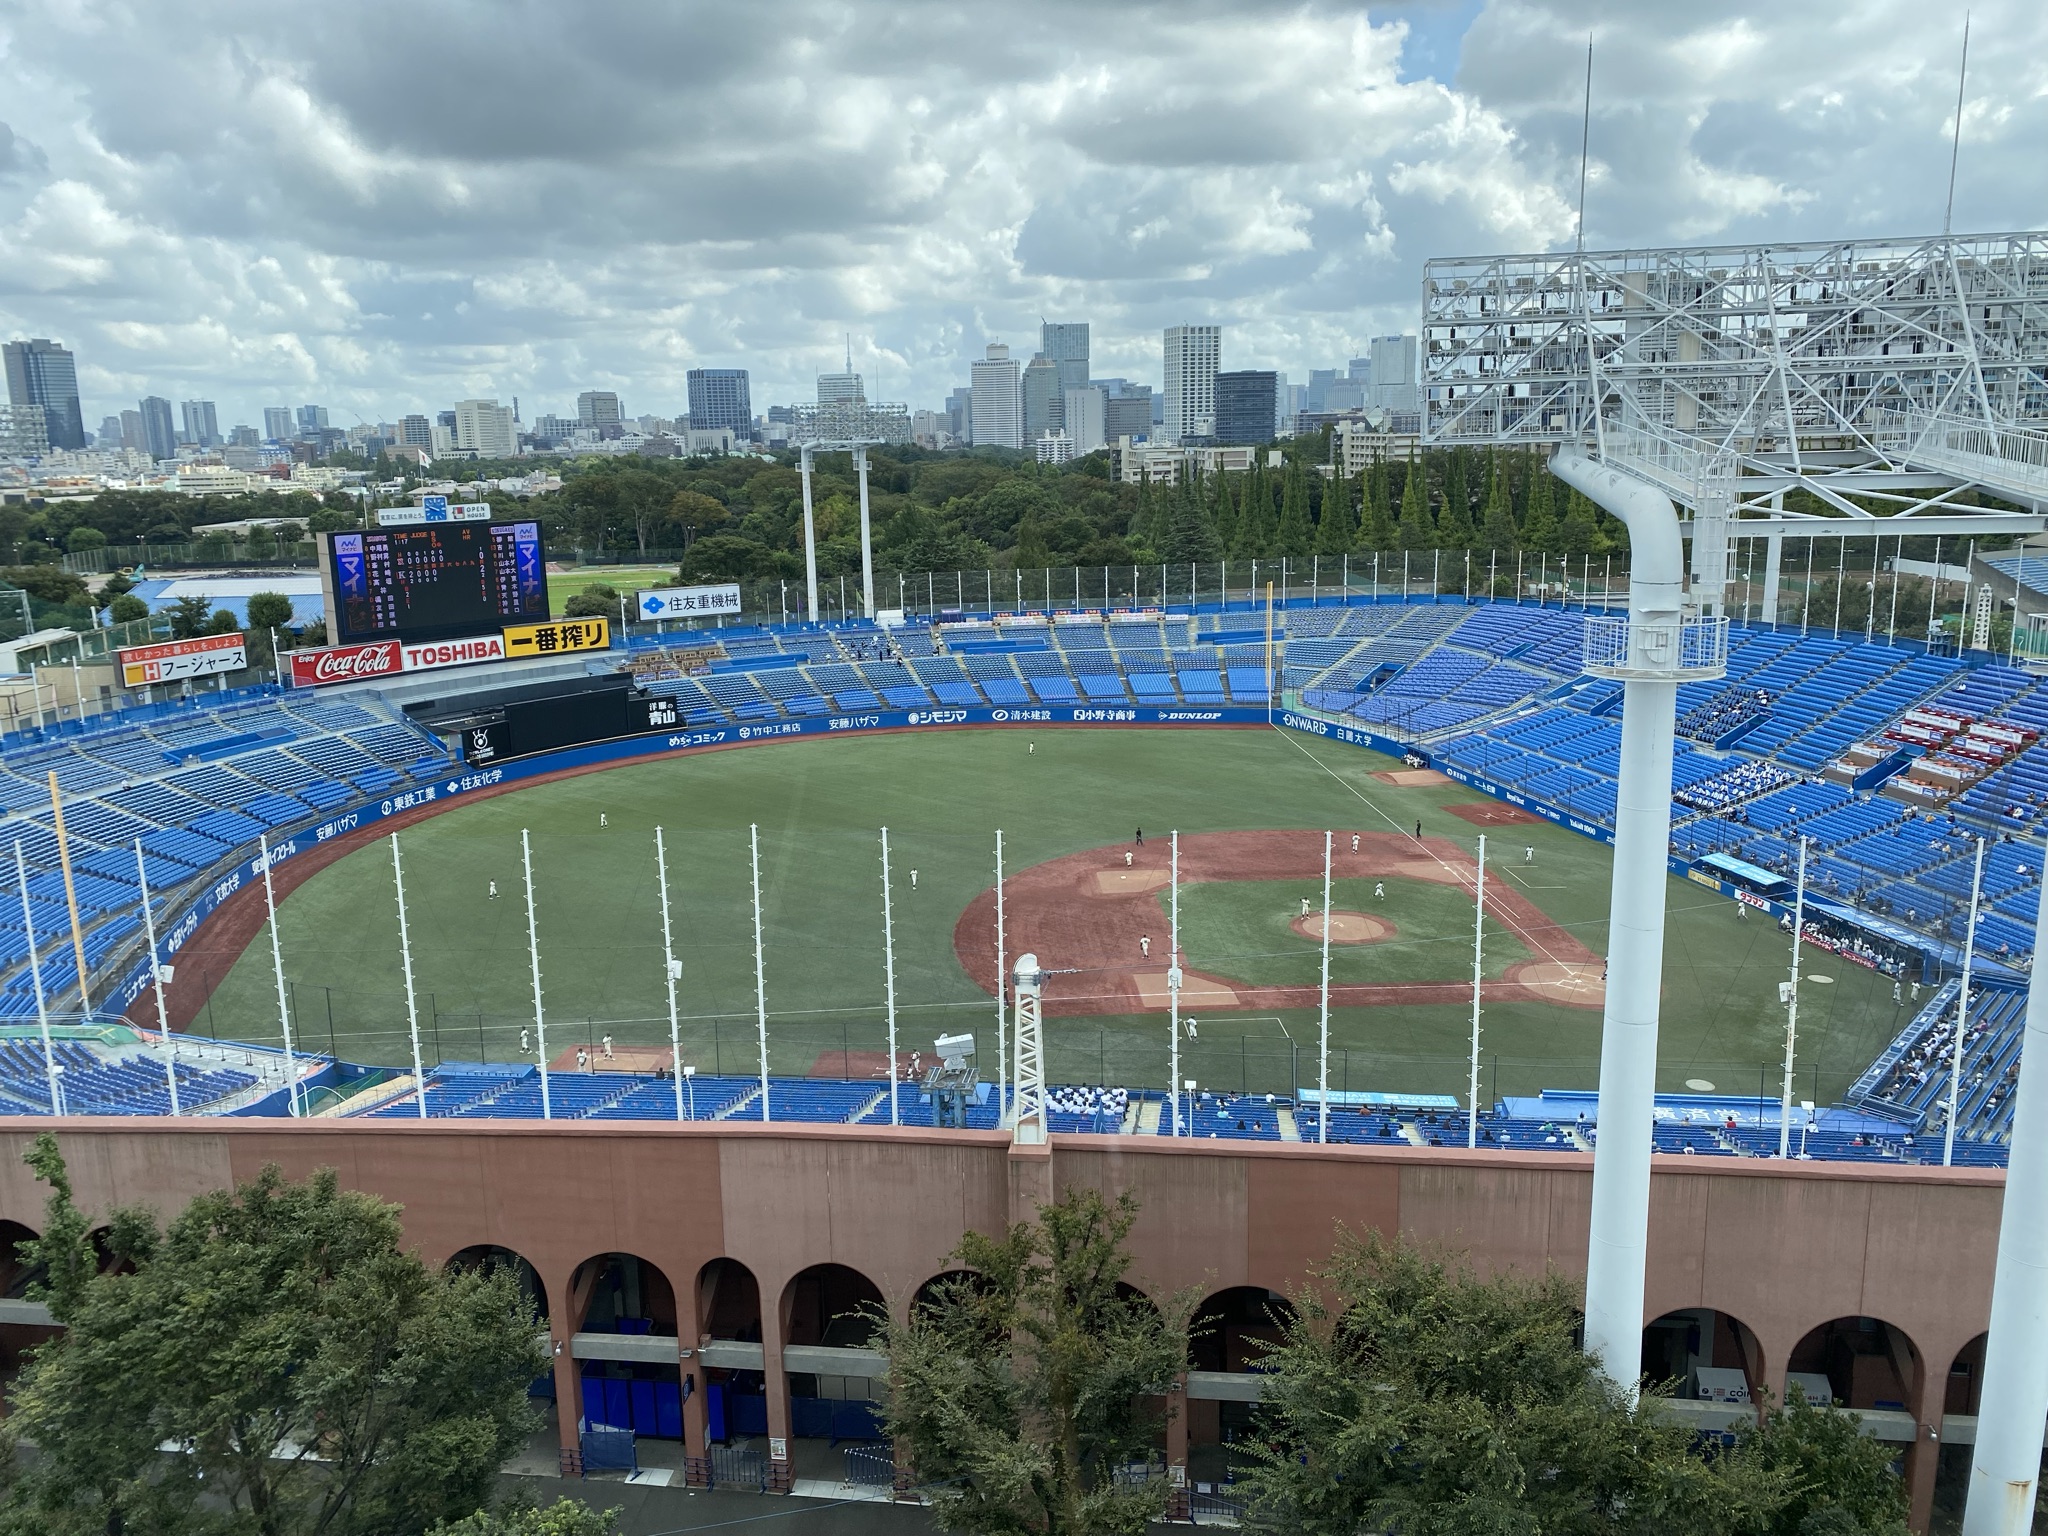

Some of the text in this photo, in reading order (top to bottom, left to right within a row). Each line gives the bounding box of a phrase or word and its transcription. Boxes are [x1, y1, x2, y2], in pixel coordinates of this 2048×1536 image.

[669, 592, 738, 611] 住友重機械
[511, 623, 602, 651] 一番搾り
[123, 637, 244, 662] 欲しかった暮らしを、しよう。
[408, 640, 501, 666] TOSHIBA
[162, 652, 244, 676] フージャース
[298, 644, 392, 679] Enjoy Coca-Cola
[144, 664, 159, 680] H
[649, 702, 673, 711] 洋服の
[1010, 710, 1051, 720] 清水建設
[1085, 710, 1136, 720] 小野寺商事
[649, 710, 676, 726] 青山
[829, 716, 879, 729] 安藤ハザマ
[920, 710, 967, 724] シモジマ
[1283, 714, 1328, 734] ONWARD
[753, 723, 800, 735] 竹中工務店
[669, 732, 725, 747] めちゃコミック
[460, 769, 502, 790] 住友化学
[394, 787, 435, 812] 東鉄工業
[316, 814, 358, 842] 安藤ハザマ
[215, 872, 240, 904] 文教大学
